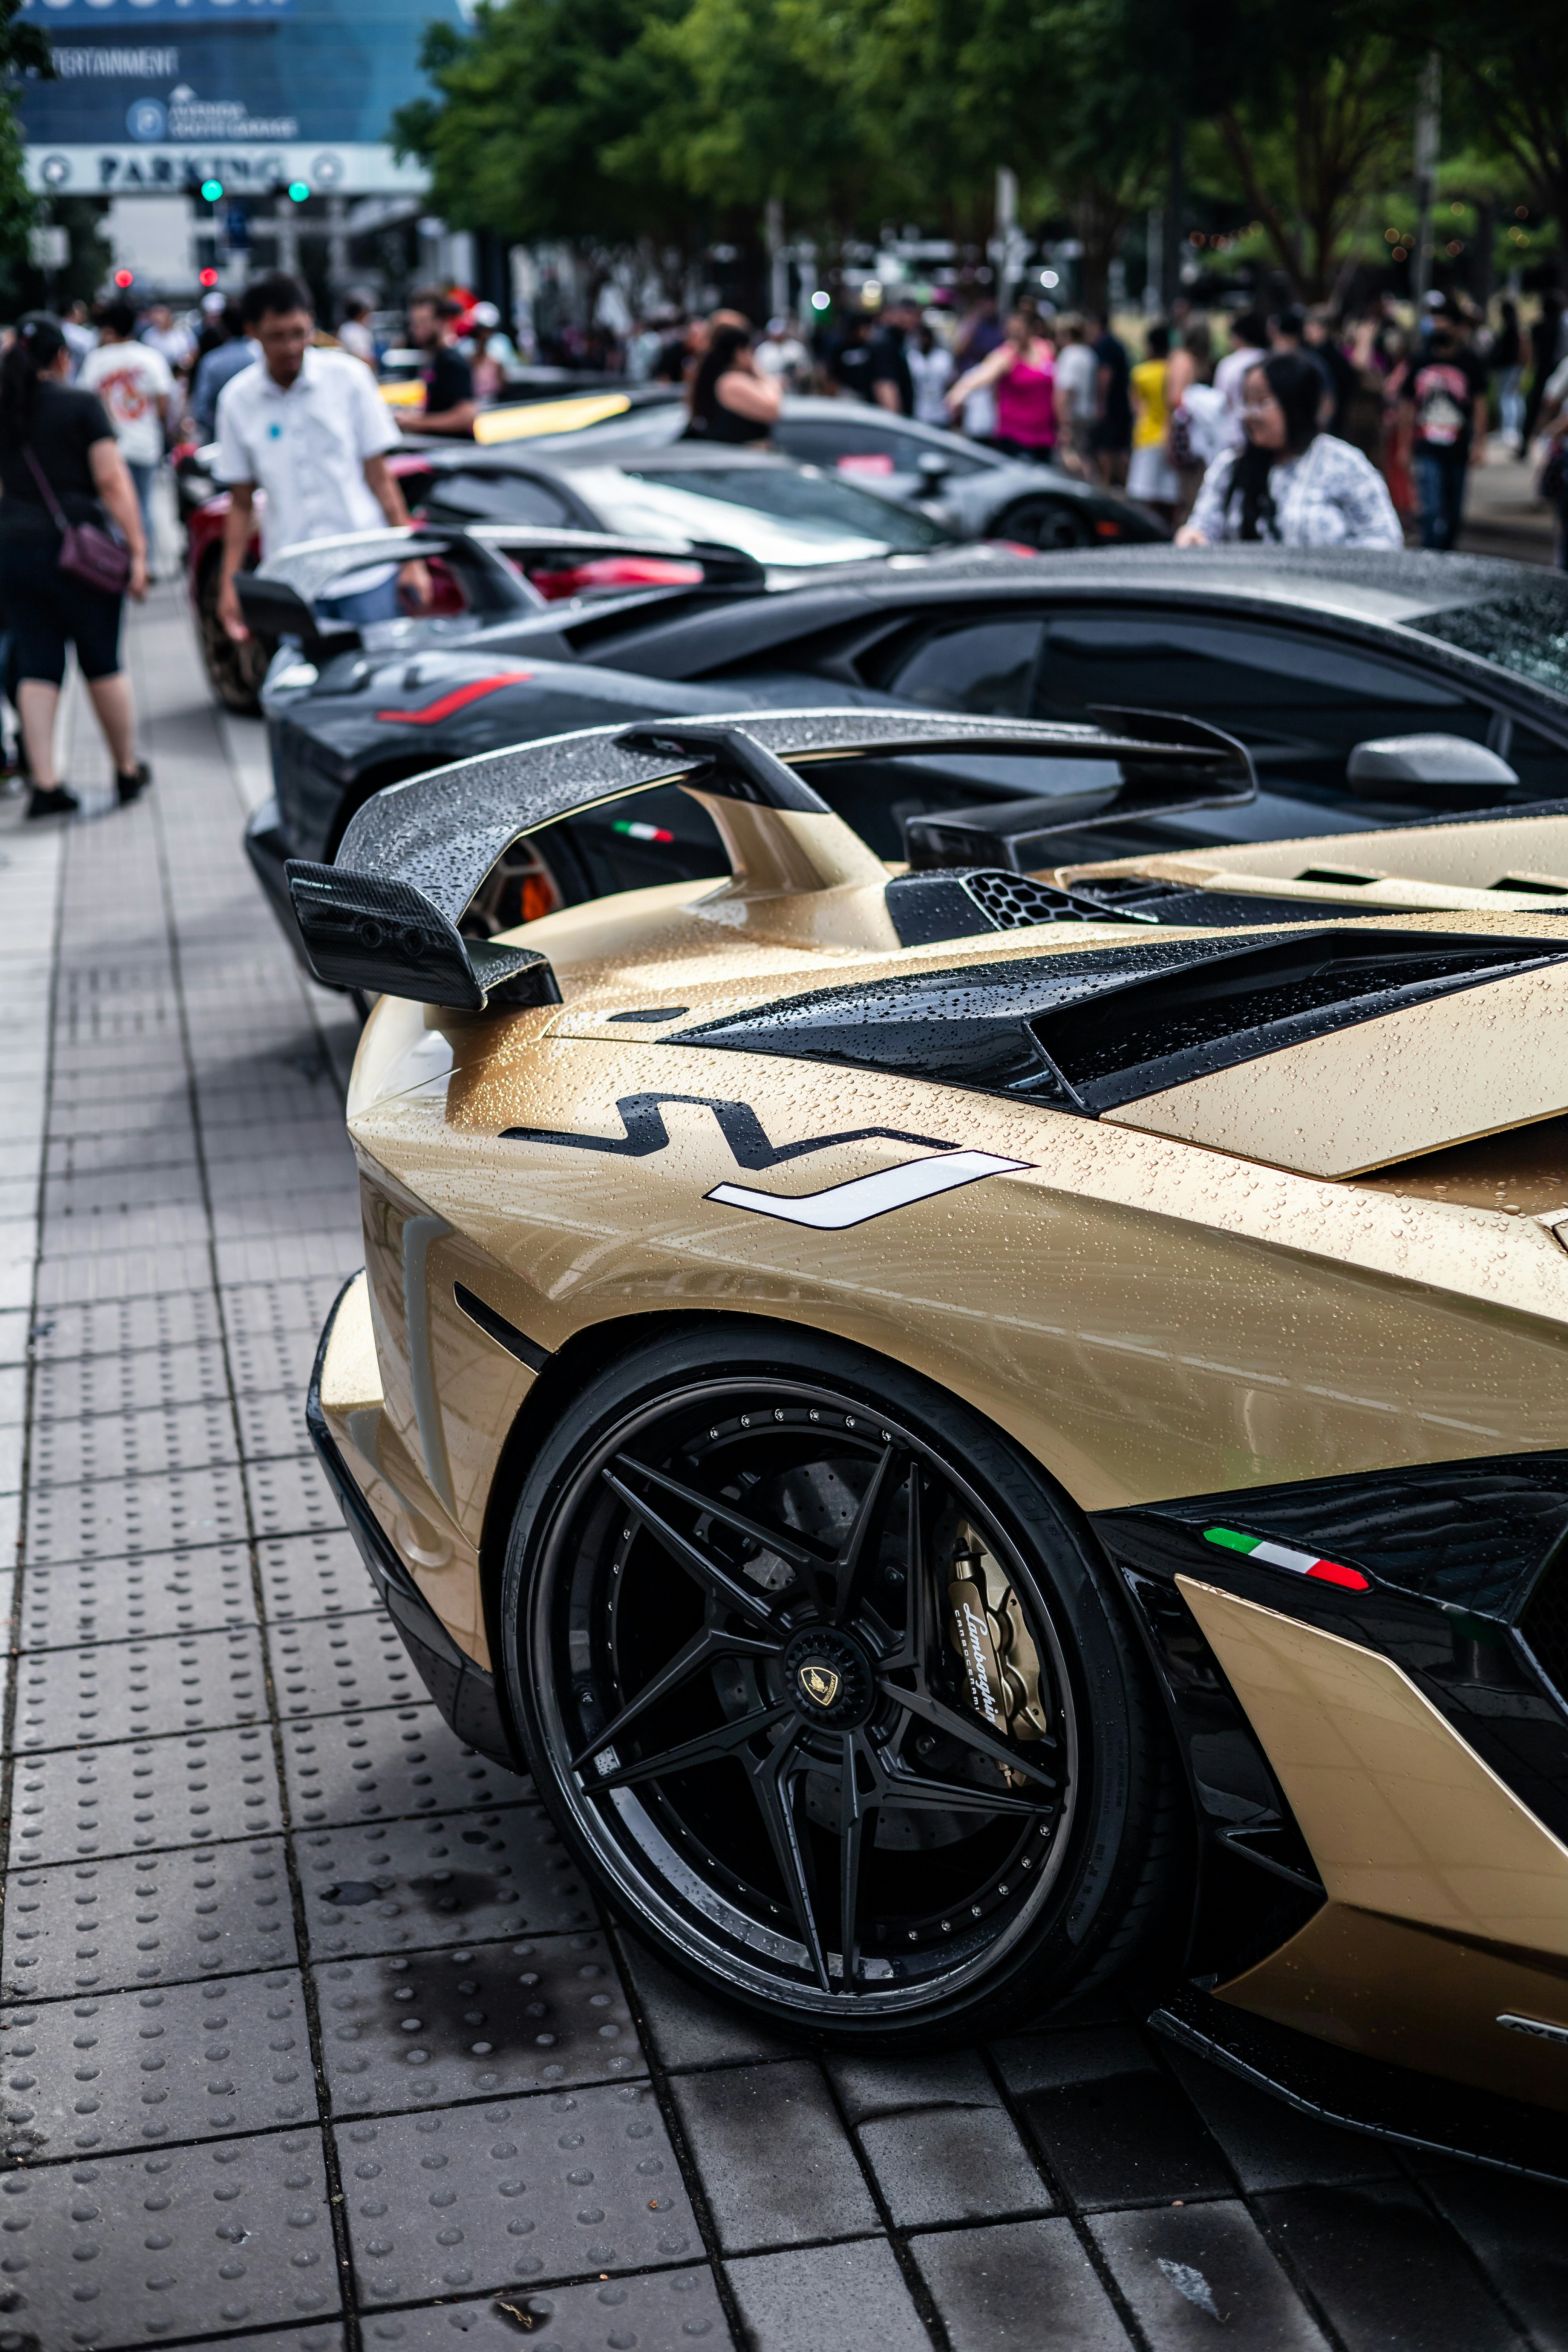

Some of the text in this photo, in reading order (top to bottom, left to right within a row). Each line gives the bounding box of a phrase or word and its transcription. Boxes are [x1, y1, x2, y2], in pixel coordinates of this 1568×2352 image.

[99, 155, 286, 185] PARKING
[955, 1610, 980, 1710] CARBOCERAMI
[963, 1603, 1002, 1730] Lamborghin
[822, 1675, 836, 1703] LAMBORGHINI
[1509, 2023, 1568, 2043] AVE
